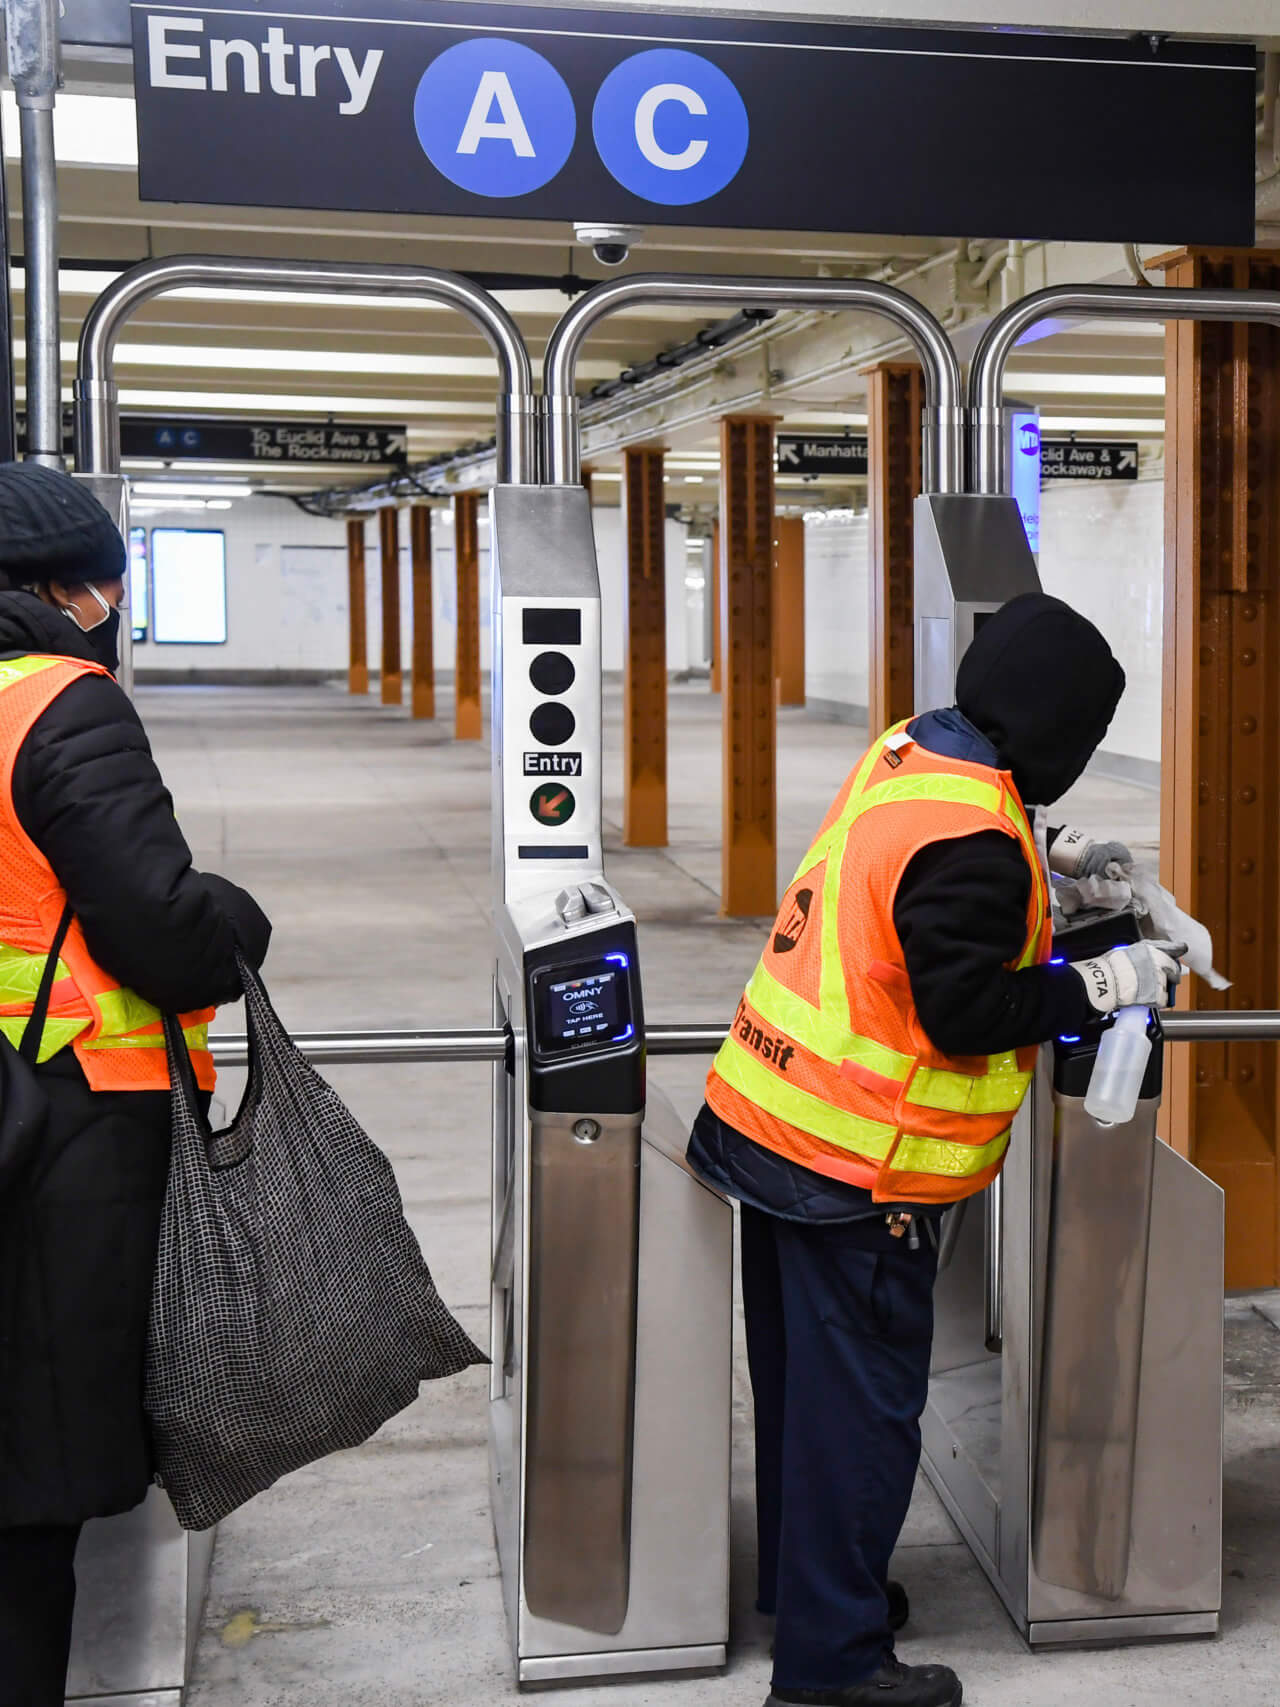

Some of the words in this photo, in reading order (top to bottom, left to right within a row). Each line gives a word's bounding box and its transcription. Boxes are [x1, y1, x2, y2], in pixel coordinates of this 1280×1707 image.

[147, 16, 384, 116] Entry
[456, 70, 537, 158] A
[633, 83, 709, 171] C
[251, 428, 270, 443] To
[276, 428, 325, 445] Euclid
[331, 431, 360, 446] Ave
[366, 431, 379, 446] &
[250, 442, 282, 457] The
[288, 443, 381, 462] Rockaways
[803, 443, 868, 458] Manhatta
[1041, 447, 1064, 461] clid
[1069, 449, 1095, 462] Ave
[1099, 449, 1111, 462] &
[1042, 462, 1113, 478] ockaways
[524, 753, 580, 776] Entry
[1086, 960, 1109, 998] NYCTA
[562, 986, 603, 1001] OMNY
